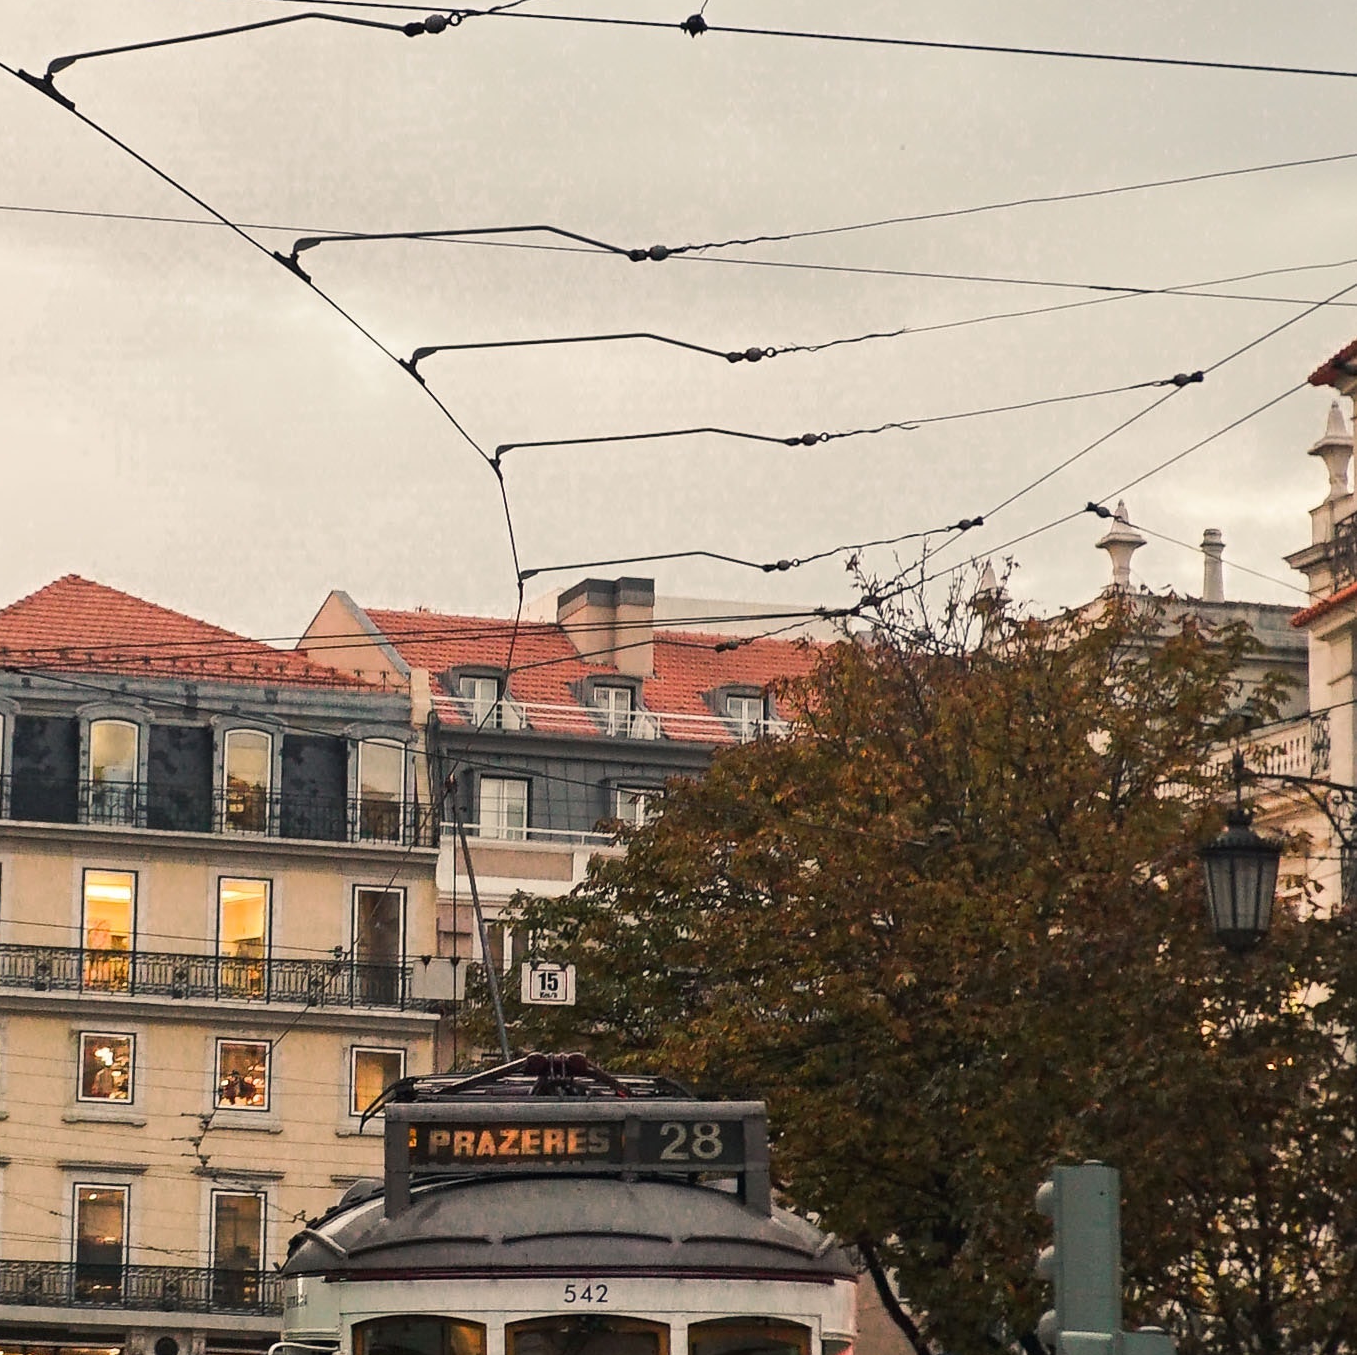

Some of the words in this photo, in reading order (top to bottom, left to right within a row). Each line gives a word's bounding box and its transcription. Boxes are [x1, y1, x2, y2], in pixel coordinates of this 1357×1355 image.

[538, 972, 559, 992] 15
[428, 1128, 610, 1157] PRAZERES
[659, 1121, 724, 1161] 28
[563, 1283, 609, 1304] 542
